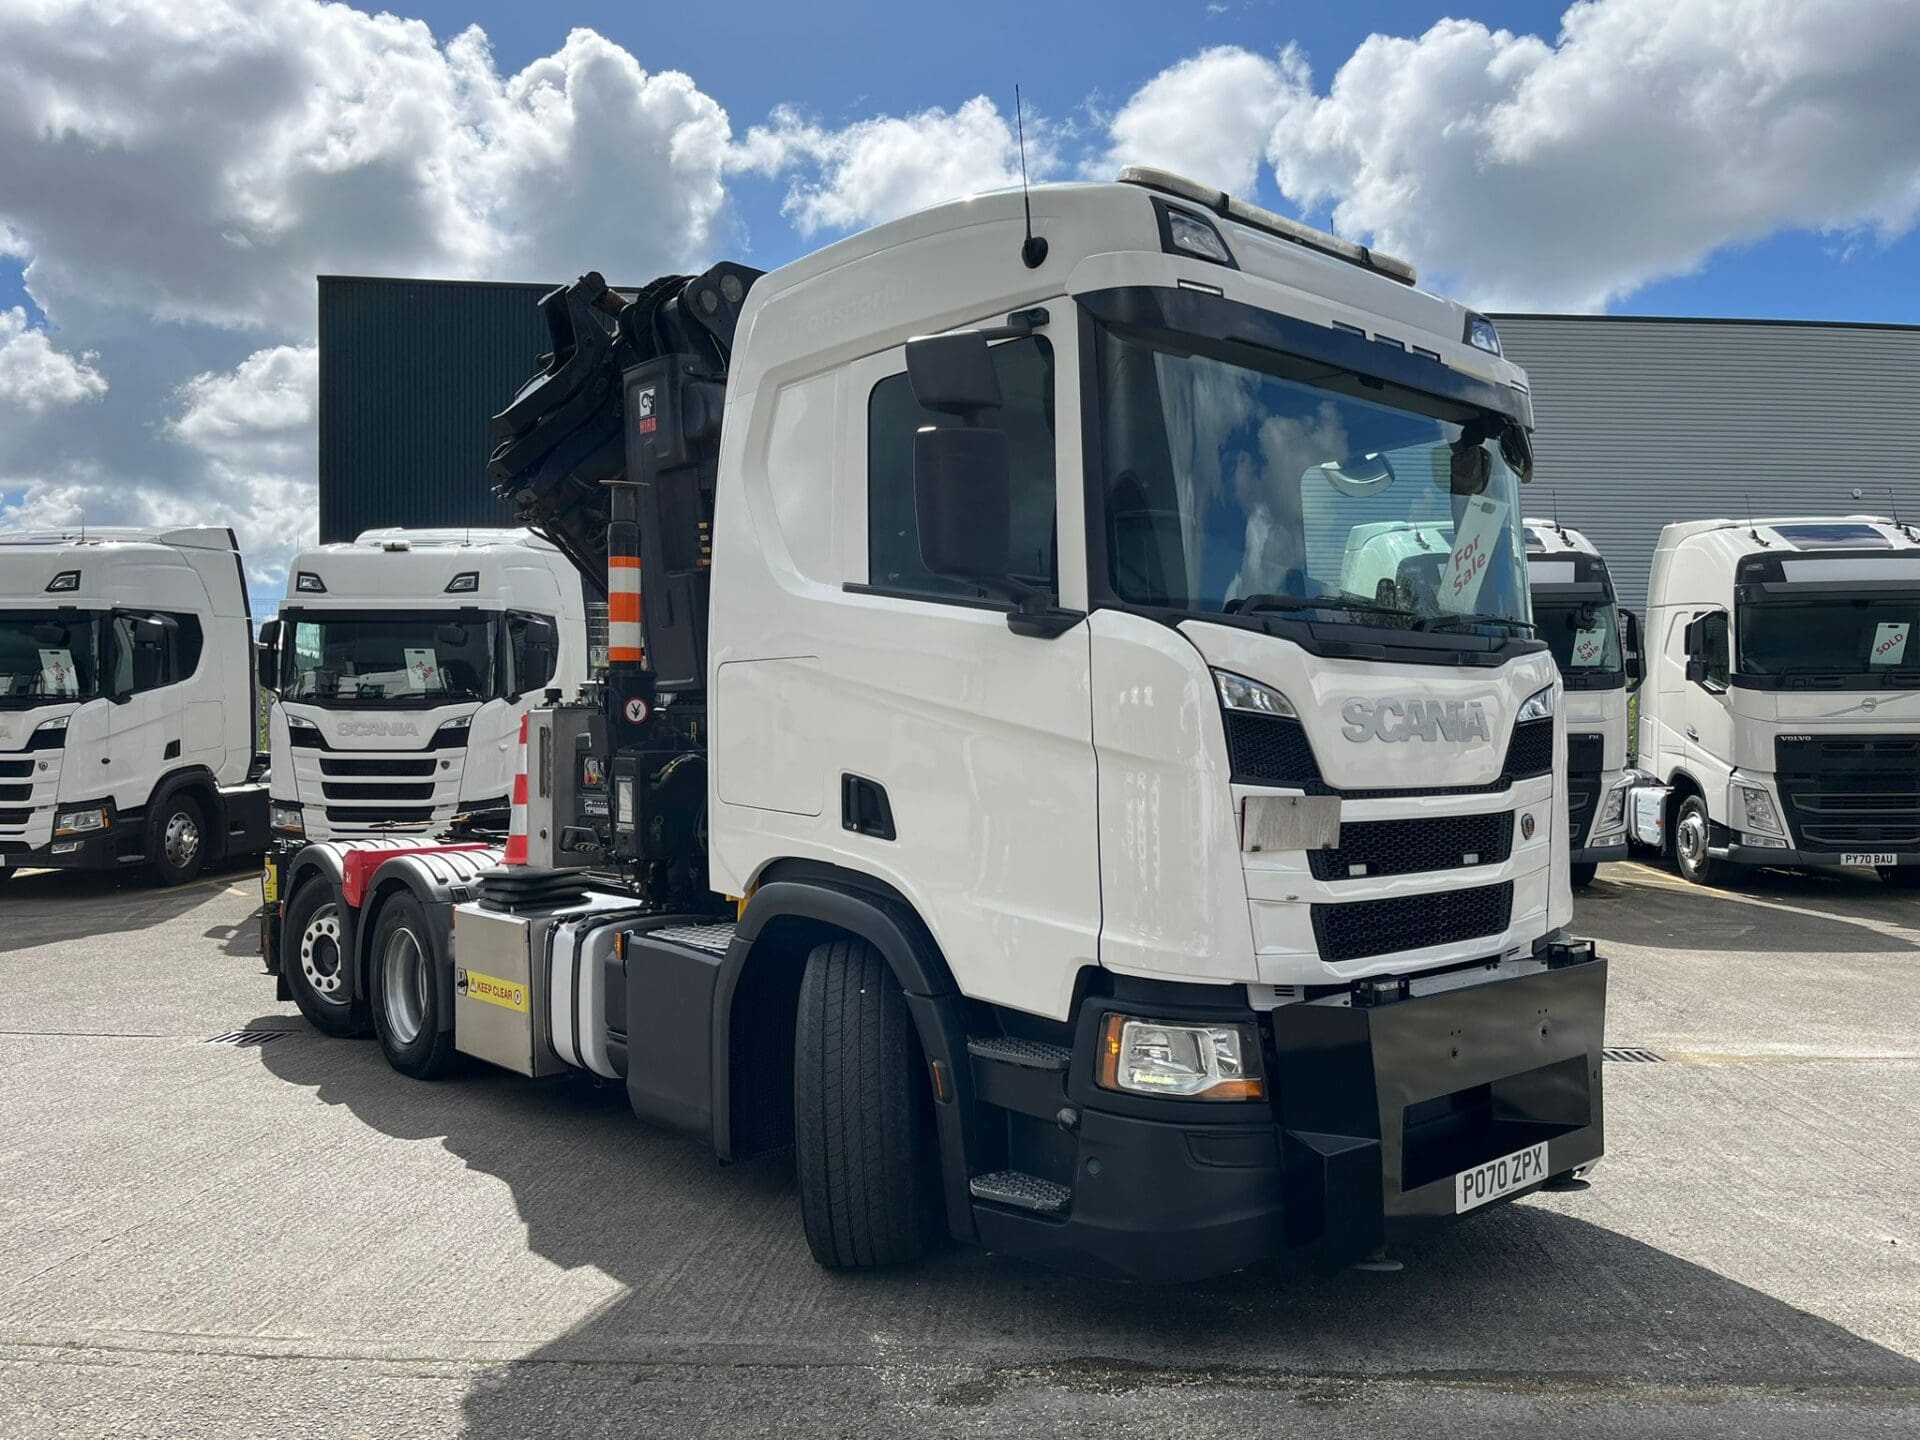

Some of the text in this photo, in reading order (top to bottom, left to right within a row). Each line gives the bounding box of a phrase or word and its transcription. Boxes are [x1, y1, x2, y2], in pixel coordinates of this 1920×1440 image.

[1454, 533, 1481, 572] For
[1453, 553, 1486, 597] Sale
[1576, 640, 1592, 654] For
[1580, 645, 1600, 662] Sale
[1875, 633, 1904, 656] SOLD
[336, 720, 419, 737] SCANIA
[1341, 697, 1491, 743] SCANIA
[1845, 854, 1893, 864] PY70 BAU
[477, 981, 513, 1000] KEEP CLEAR
[1463, 1146, 1542, 1205] PO70 ZPX
